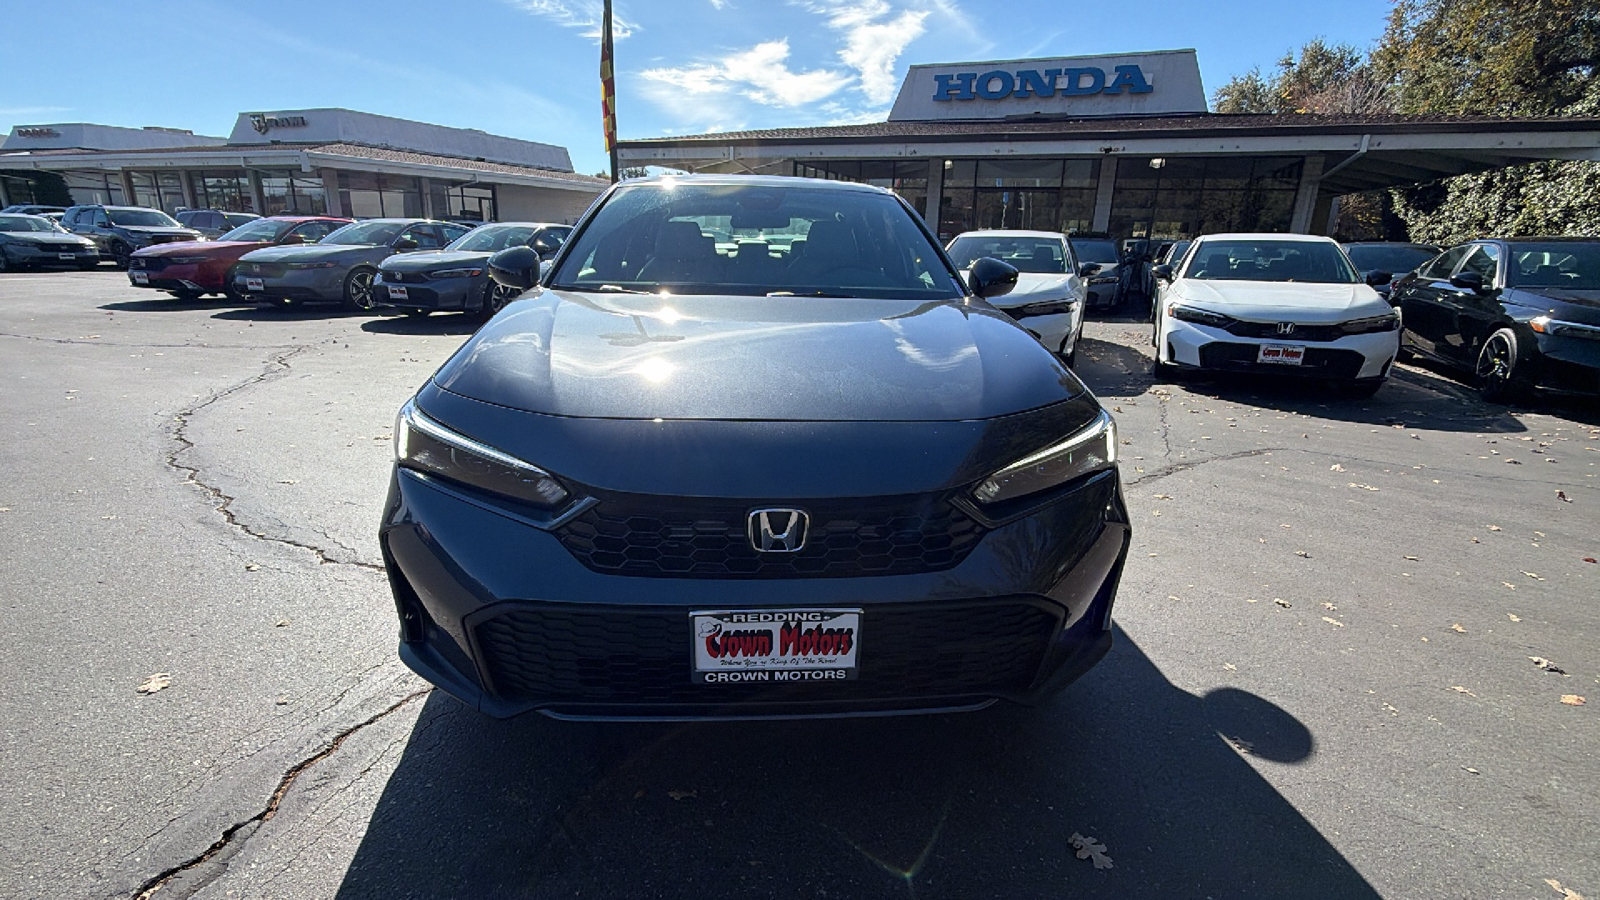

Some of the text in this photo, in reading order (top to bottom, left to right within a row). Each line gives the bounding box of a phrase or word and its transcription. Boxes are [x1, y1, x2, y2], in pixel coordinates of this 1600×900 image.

[933, 65, 1153, 101] HONDA
[733, 612, 821, 622] REDDING
[705, 621, 853, 658] Crown Motors
[790, 658, 800, 666] Of
[704, 670, 846, 682] CROWN MOTORS
